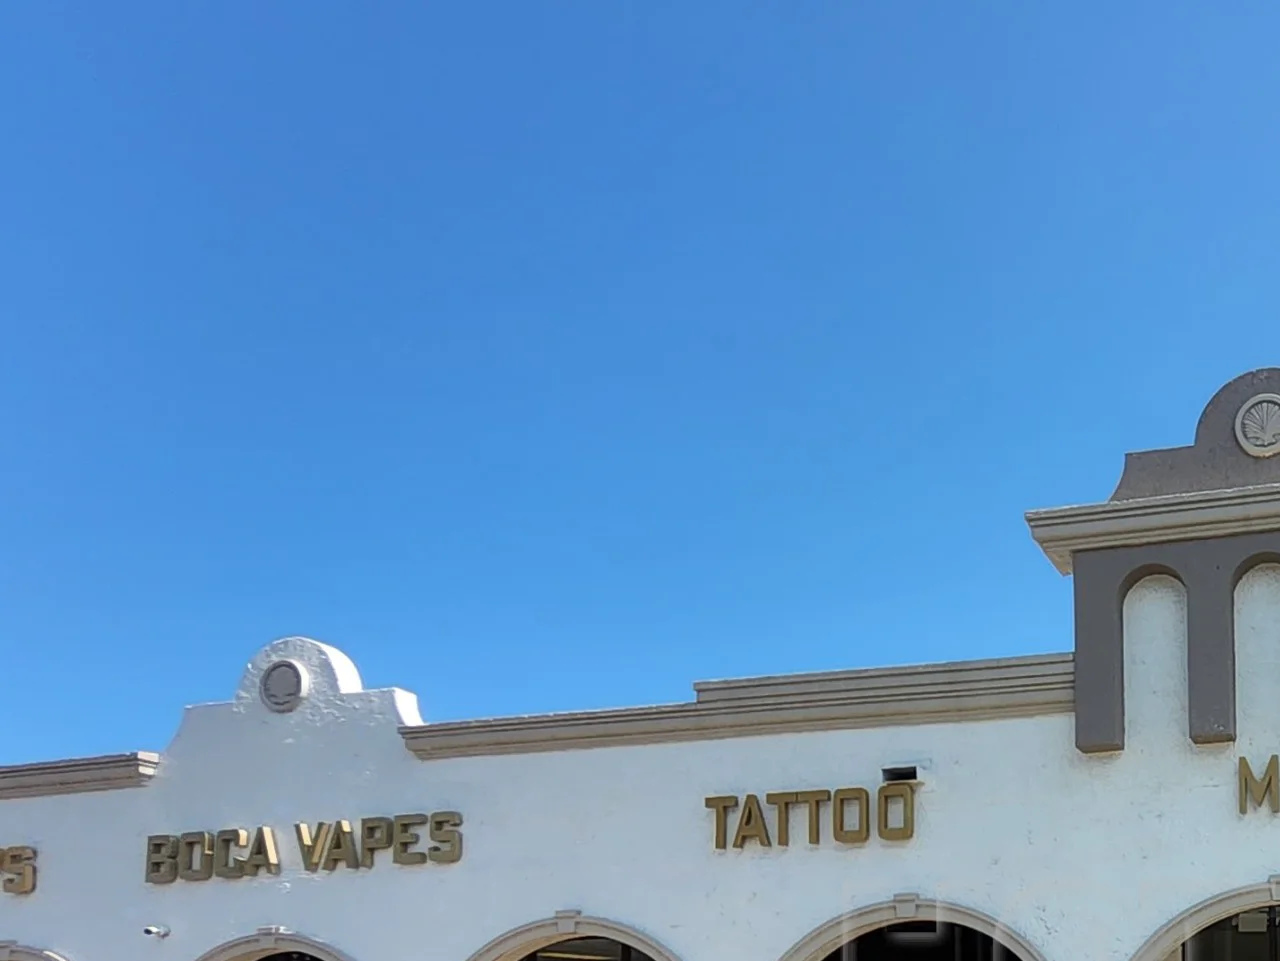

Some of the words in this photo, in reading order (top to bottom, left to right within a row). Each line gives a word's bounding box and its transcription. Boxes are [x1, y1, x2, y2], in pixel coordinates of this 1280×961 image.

[145, 825, 282, 884] BOCA
[294, 811, 464, 873] VAPES
[704, 782, 915, 850] TATTOO
